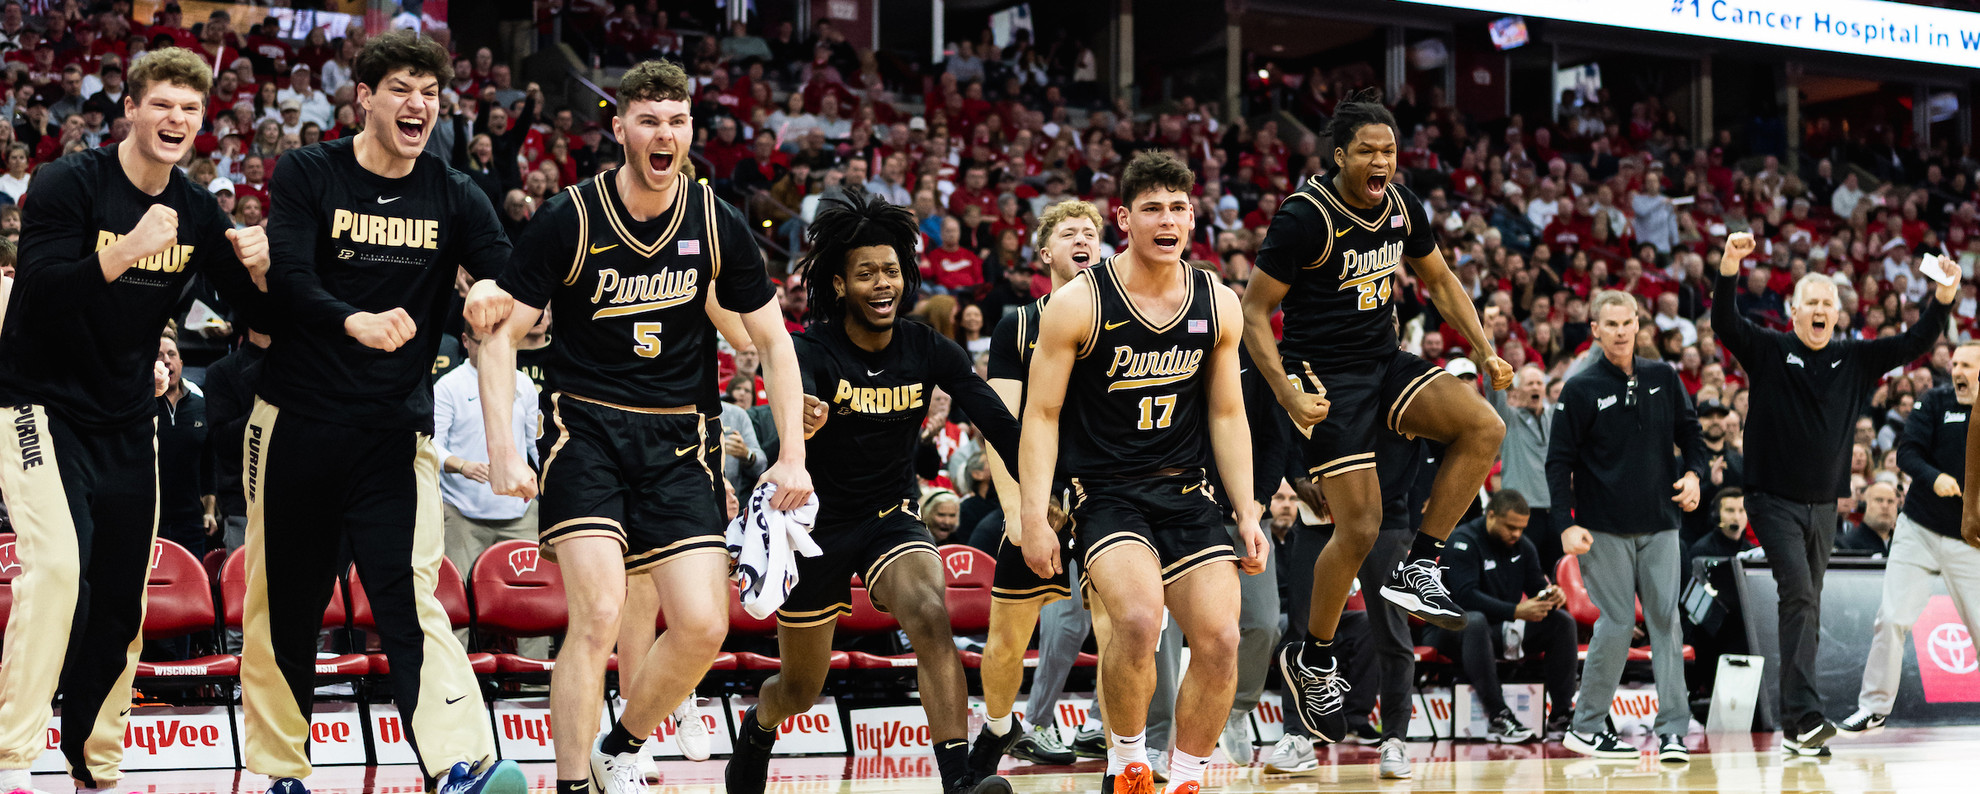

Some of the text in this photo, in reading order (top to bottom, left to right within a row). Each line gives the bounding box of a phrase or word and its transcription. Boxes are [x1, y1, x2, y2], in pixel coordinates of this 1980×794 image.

[1711, 0, 1802, 30] Cancer
[1814, 12, 1918, 44] Hospital
[1929, 23, 1950, 48] in
[331, 208, 439, 250] PURDUE
[95, 229, 195, 273] PDUE
[1338, 240, 1404, 281] Purdue
[590, 266, 698, 304] Purdue
[1357, 276, 1393, 311] 24
[633, 322, 662, 359] 5
[1106, 345, 1203, 378] Purdue
[833, 378, 924, 414] PURDUE
[1137, 393, 1178, 431] 17
[14, 404, 44, 472] PURDUE
[248, 424, 263, 504] PURDUE
[509, 547, 540, 577] W
[946, 551, 974, 579] W
[154, 666, 208, 676] WISCONSIN
[856, 721, 931, 756] HyVee
